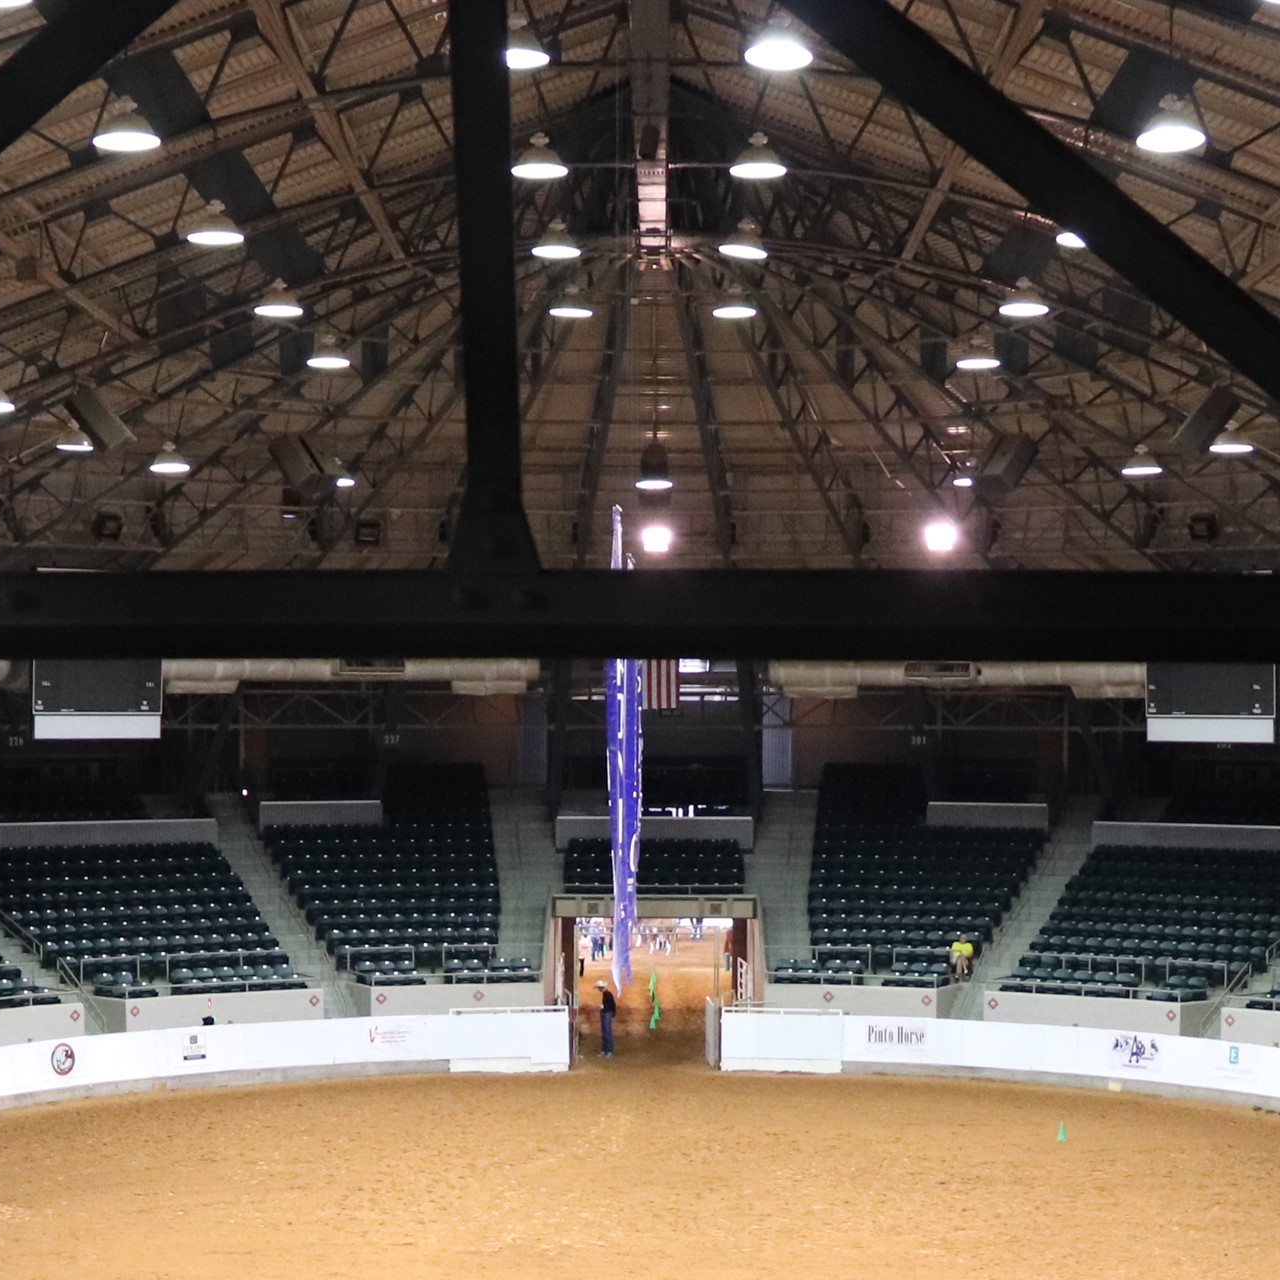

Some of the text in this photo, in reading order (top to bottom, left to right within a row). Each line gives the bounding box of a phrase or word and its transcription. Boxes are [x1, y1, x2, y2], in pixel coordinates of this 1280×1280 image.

[911, 736, 926, 745] 201
[868, 1025, 925, 1044] Pinto Horse
